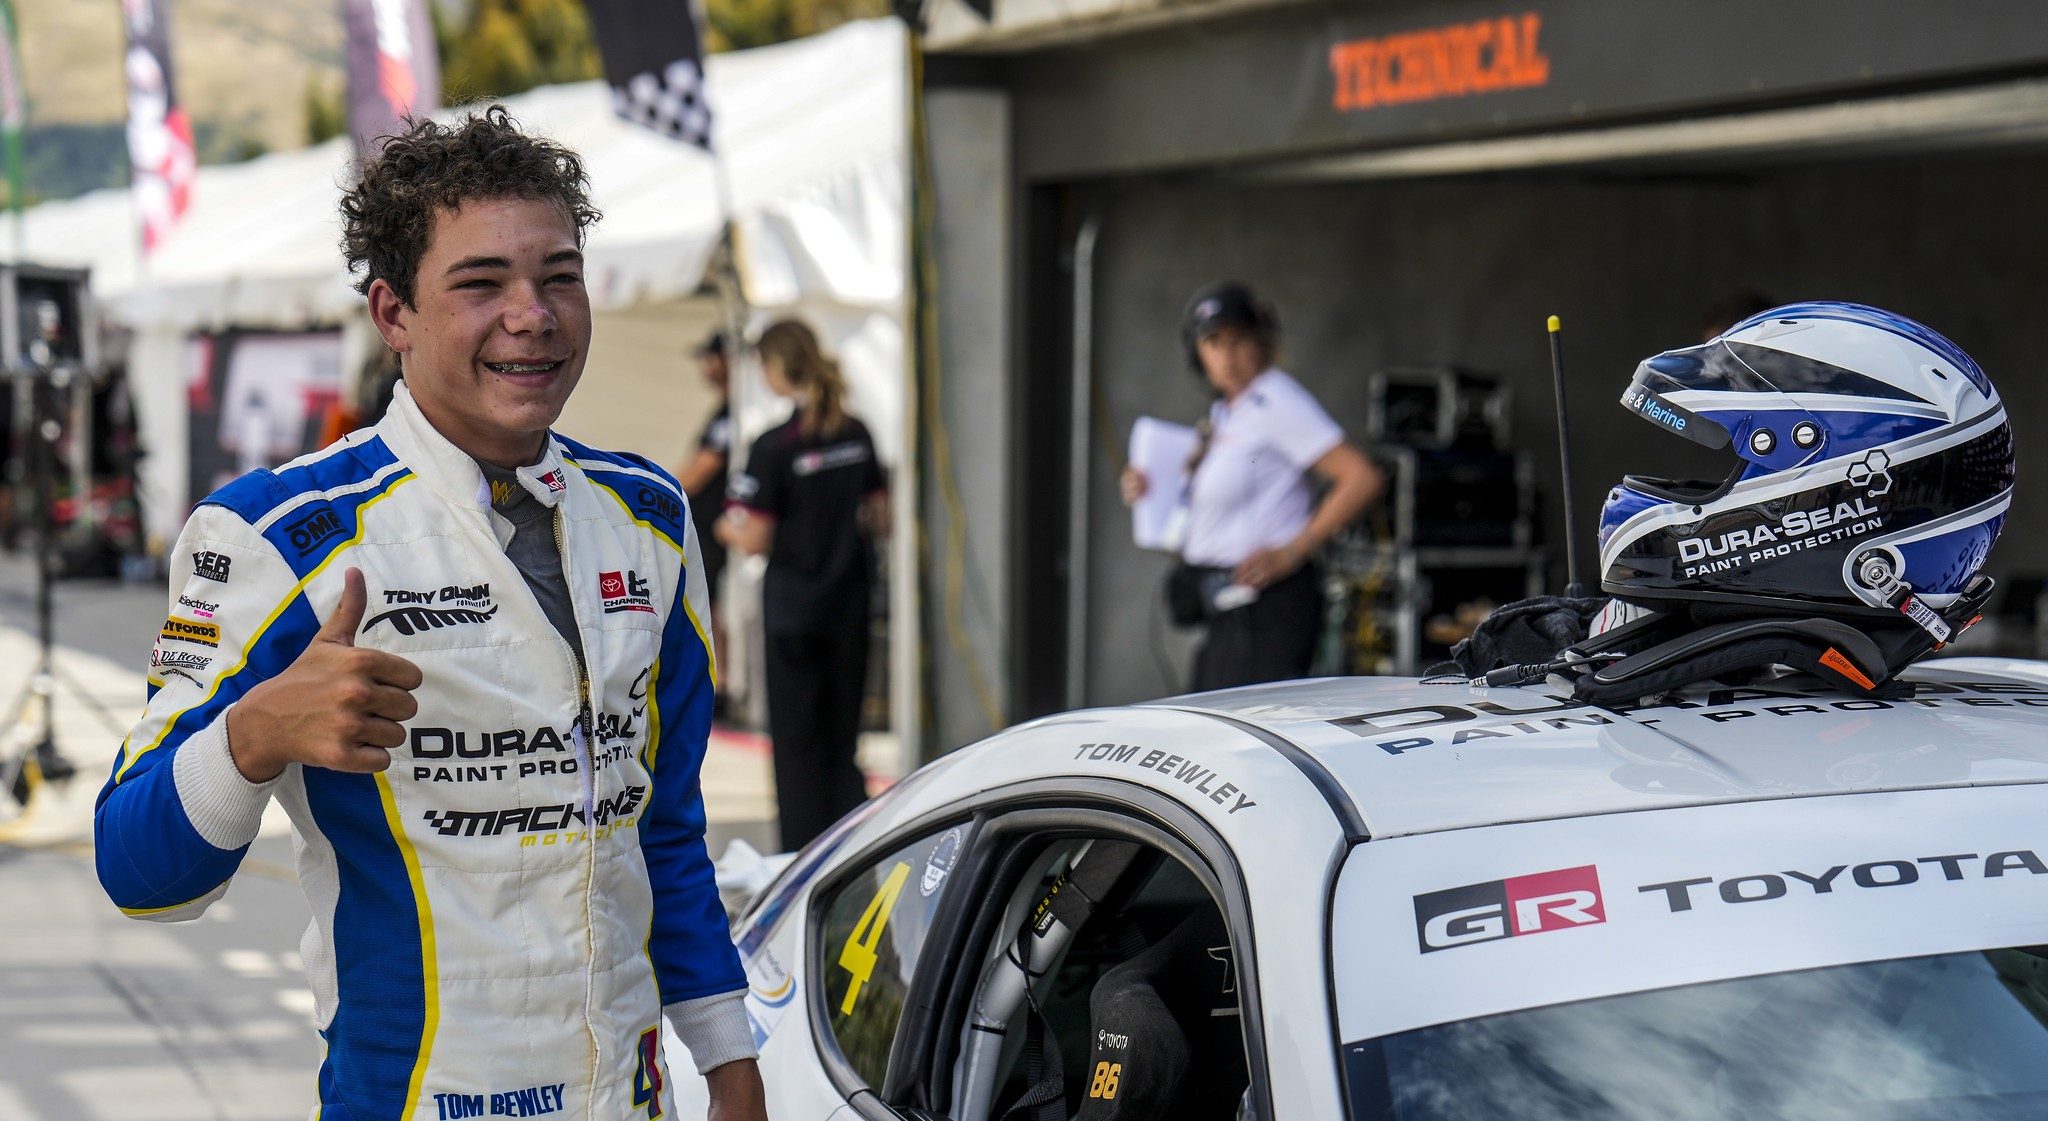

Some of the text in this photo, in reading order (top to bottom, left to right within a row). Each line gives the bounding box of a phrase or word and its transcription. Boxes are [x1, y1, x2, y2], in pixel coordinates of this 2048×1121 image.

[1329, 11, 1549, 112] TECHNICAL
[1642, 398, 1686, 431] Marine
[1677, 497, 1878, 563] DURA-SEAL
[1684, 517, 1883, 579] PAINT PROTECTION
[383, 590, 436, 604] TONY
[1934, 624, 1947, 637] 2021
[413, 766, 508, 783] PAINT
[1074, 743, 1257, 815] TOM BEWLEY
[1638, 850, 2048, 914] TOYOTA
[838, 861, 911, 1016] 4
[1420, 886, 1603, 950] GR
[433, 1083, 566, 1121] TOM BEWLEY
[630, 1024, 663, 1121] 4
[1089, 1061, 1121, 1100] 86
